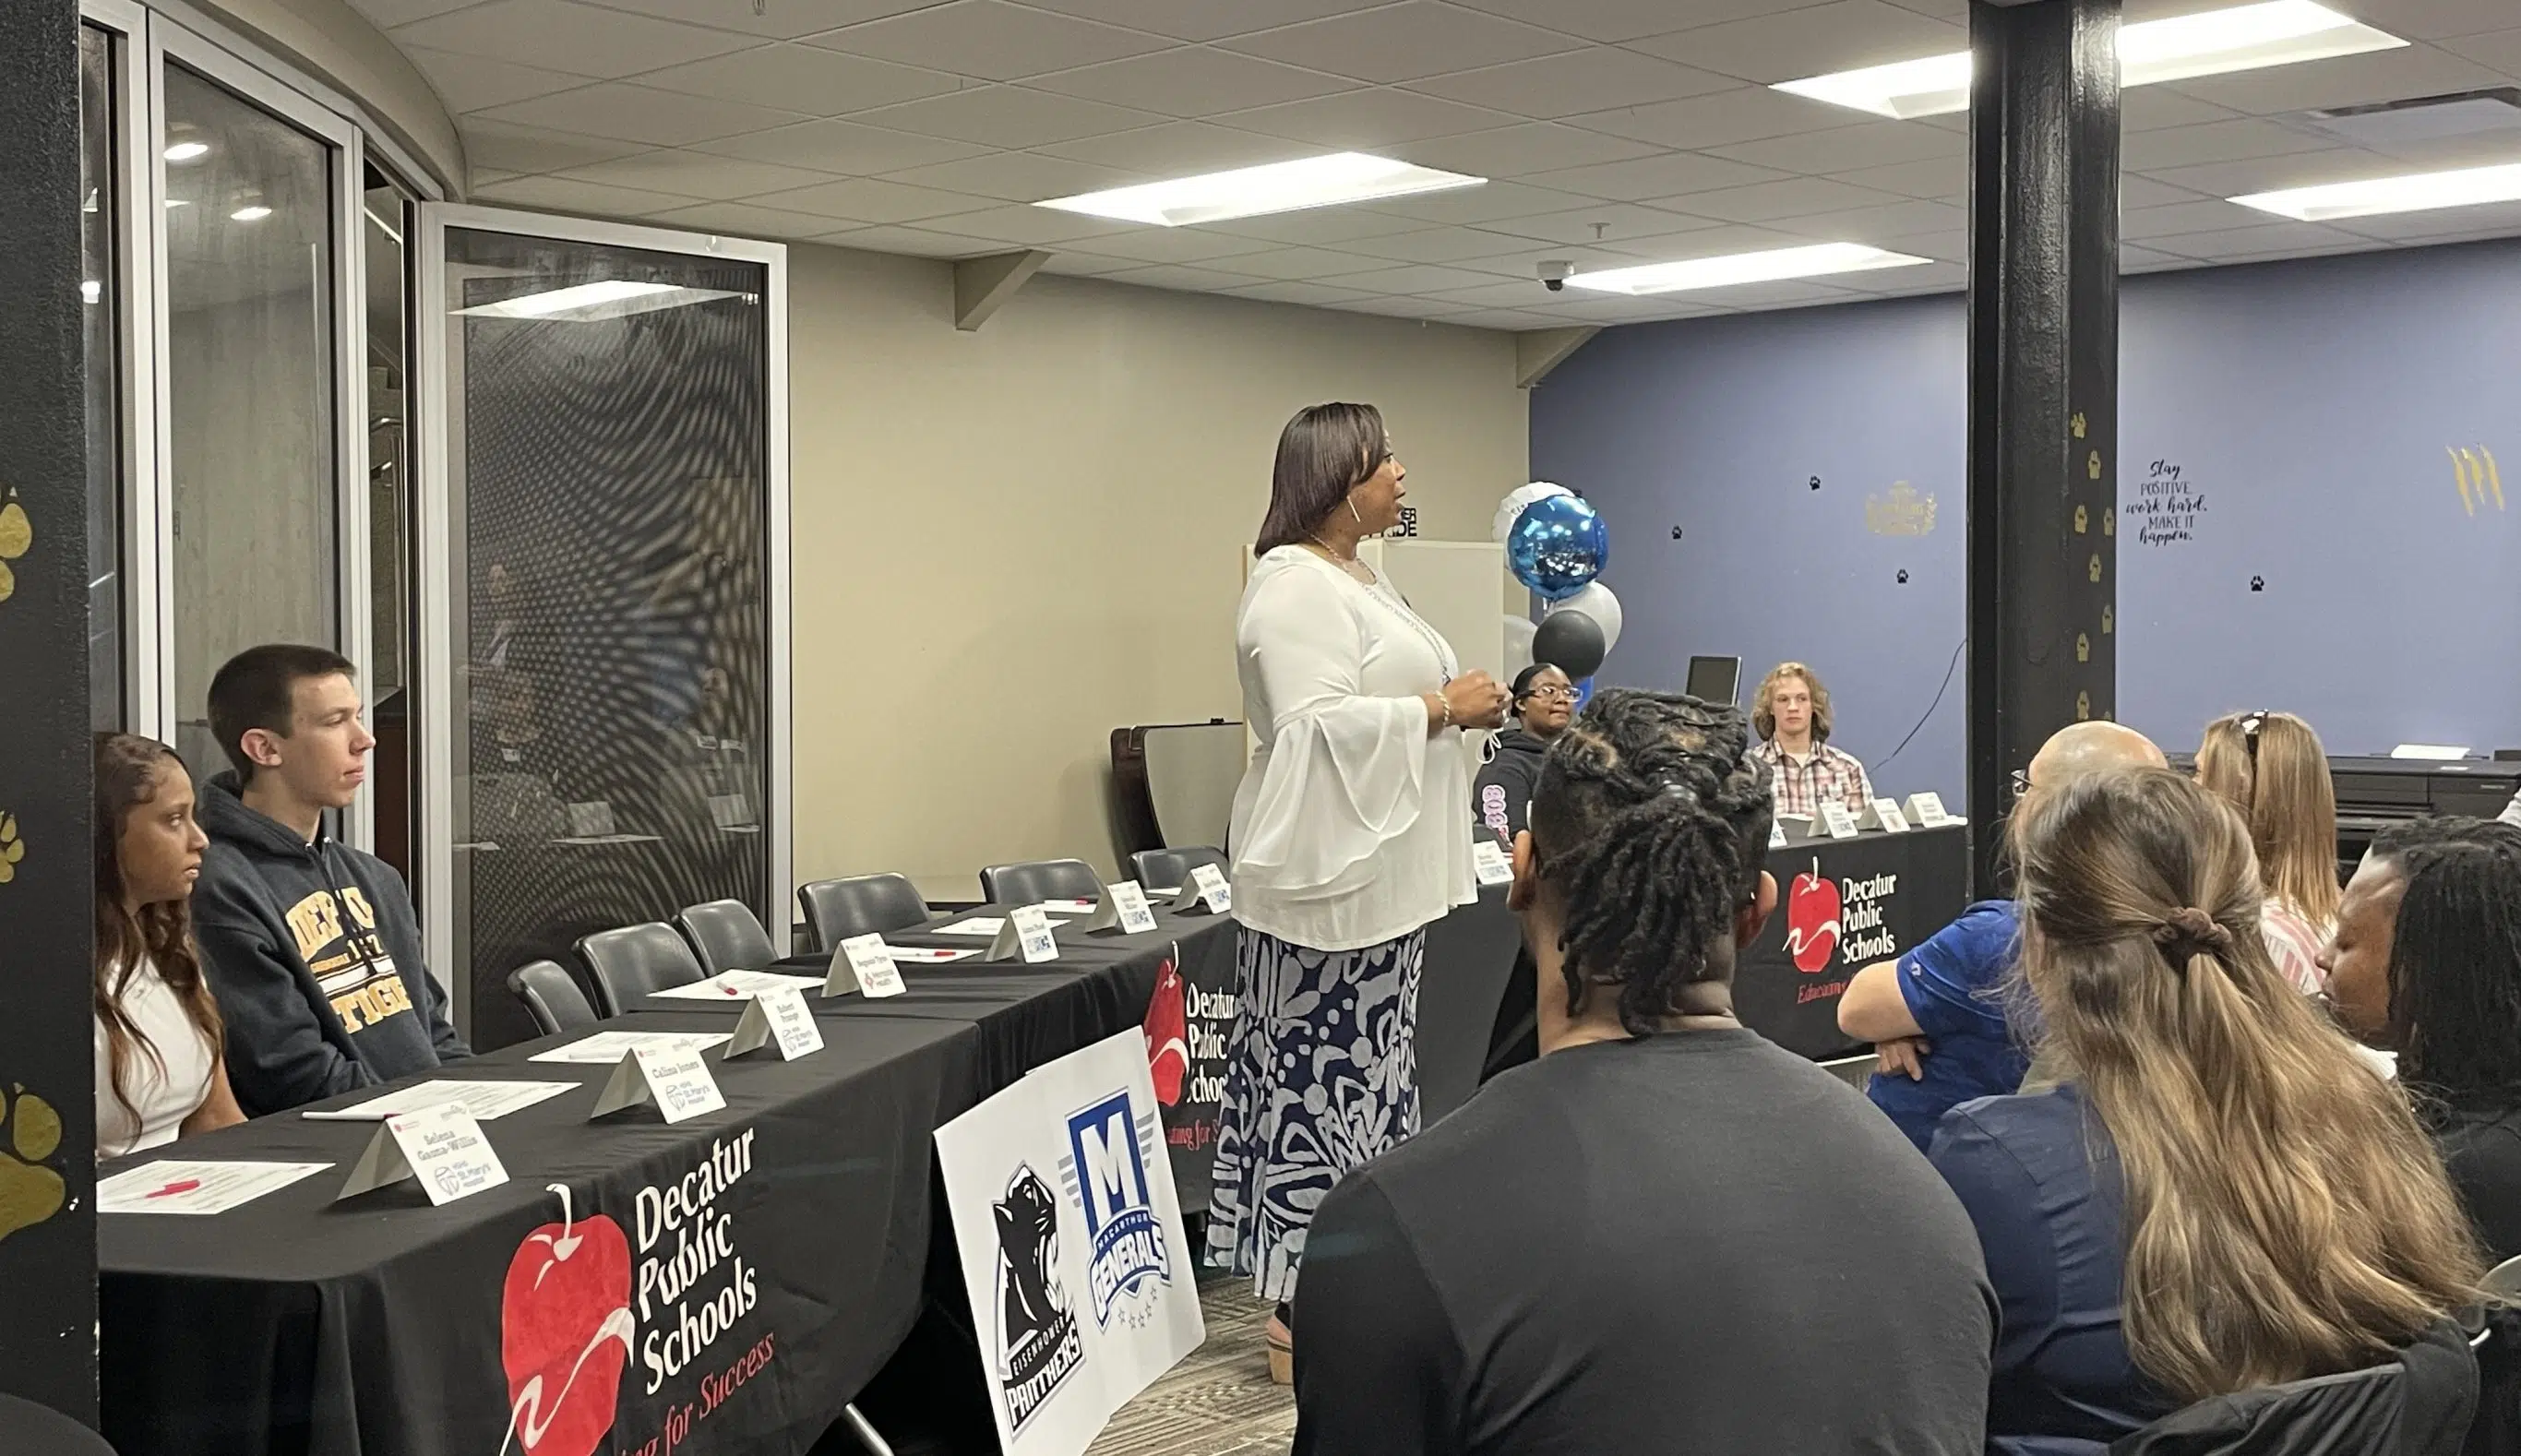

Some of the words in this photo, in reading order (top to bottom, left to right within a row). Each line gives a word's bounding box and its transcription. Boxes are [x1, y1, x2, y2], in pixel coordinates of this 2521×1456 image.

[2141, 481, 2192, 495] POSITIVE
[2149, 459, 2180, 481] Stay
[2125, 497, 2159, 514] work
[2167, 495, 2207, 514] hard.
[2148, 516, 2180, 531] MAKE
[2184, 515, 2194, 529] IT
[2139, 525, 2192, 547] happen.
[1842, 873, 1897, 904] Decatur
[1842, 901, 1883, 934] Public
[1842, 926, 1895, 965] Schools
[636, 1128, 754, 1254] Decatur
[1080, 1112, 1141, 1233] M
[1097, 1212, 1149, 1250] MACARTHUR
[639, 1207, 734, 1322] Public
[1091, 1224, 1170, 1322] GENERALS
[644, 1257, 757, 1395] Schools
[1013, 1316, 1065, 1376] EISENHOWER
[1006, 1320, 1081, 1426] PANTHERS
[664, 1402, 694, 1456] for
[699, 1331, 775, 1421] Success
